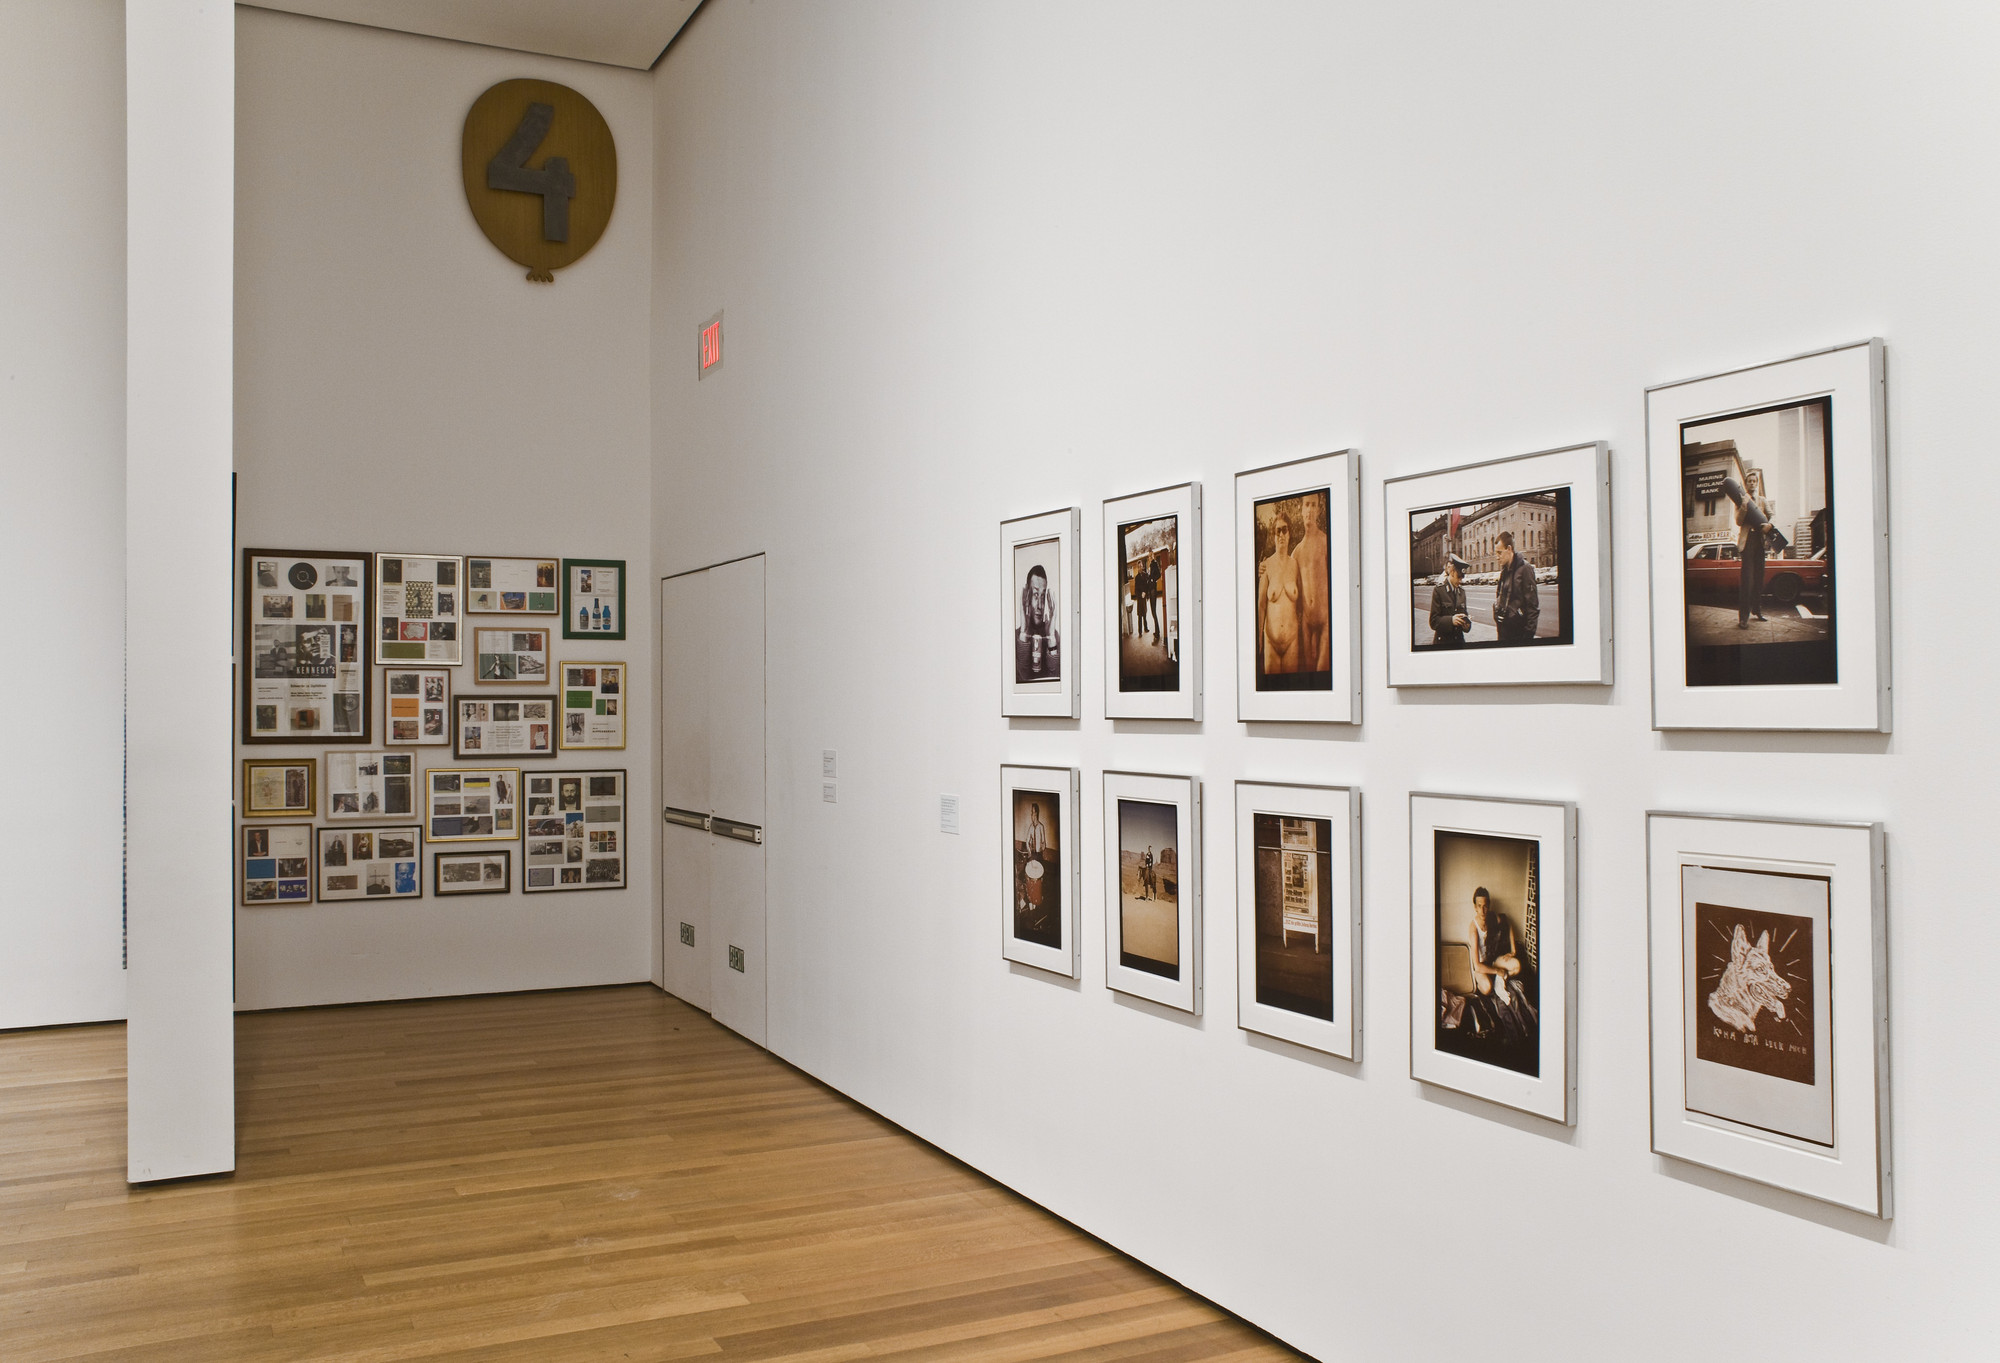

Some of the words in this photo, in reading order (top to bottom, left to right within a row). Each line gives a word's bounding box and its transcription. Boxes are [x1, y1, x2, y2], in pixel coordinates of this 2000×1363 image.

[488, 102, 576, 242] 4
[703, 321, 720, 369] EXIT
[296, 665, 336, 675] KENNEDY'S
